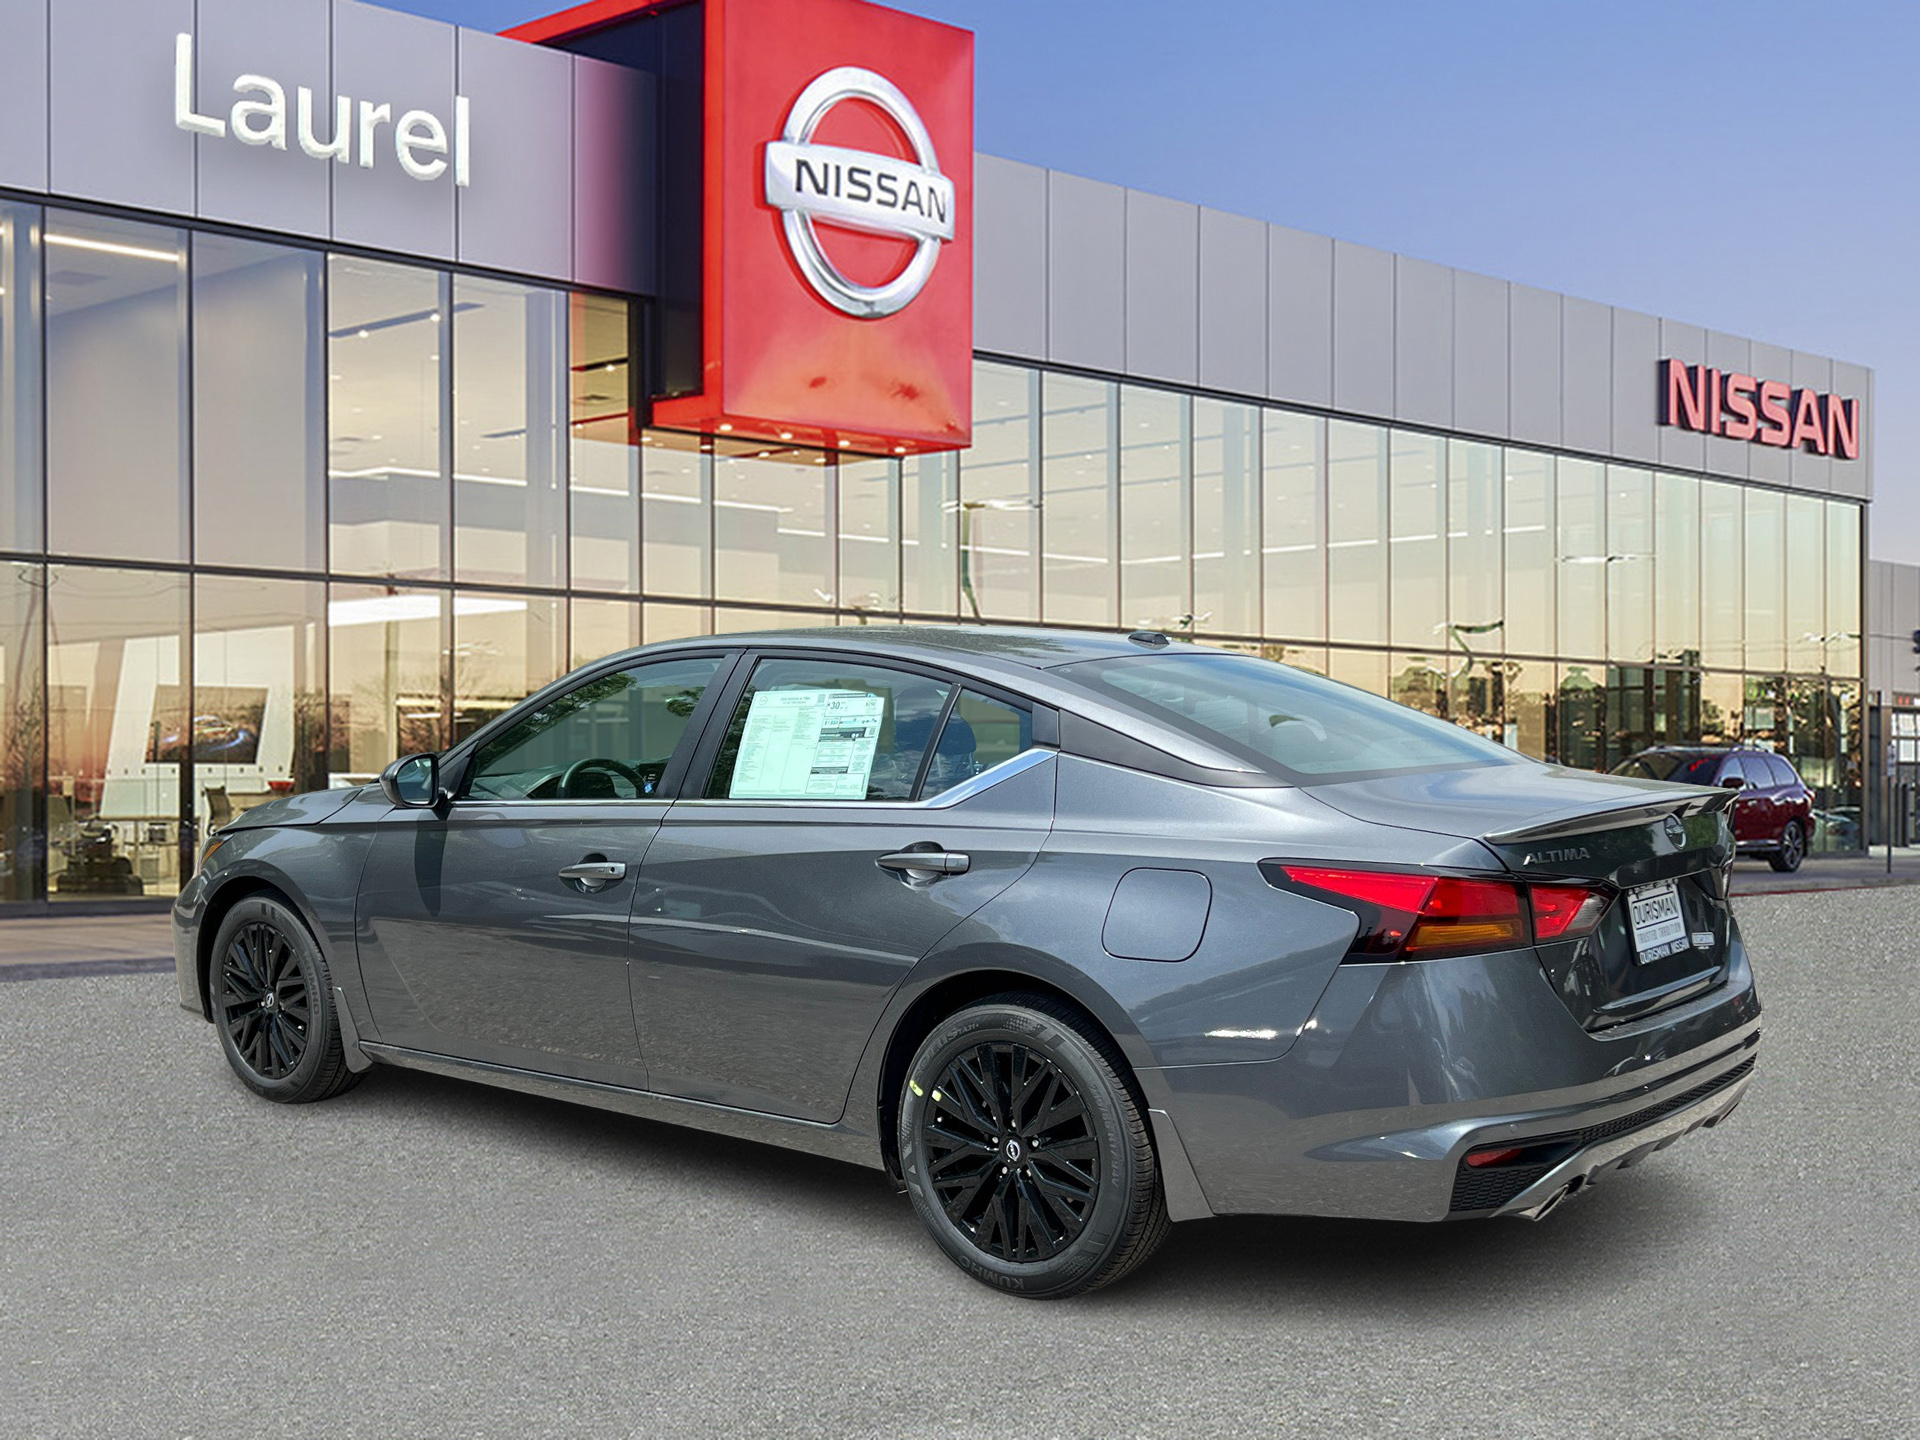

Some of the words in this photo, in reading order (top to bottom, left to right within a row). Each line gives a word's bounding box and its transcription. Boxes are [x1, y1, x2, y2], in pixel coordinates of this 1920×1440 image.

[175, 33, 470, 187] Laurel
[795, 158, 947, 224] NISSAN
[1658, 358, 1860, 460] NISSAN
[1522, 847, 1591, 866] ALTIMA
[1633, 896, 1677, 925] OURISMAN
[958, 1255, 1025, 1289] KUMHO
